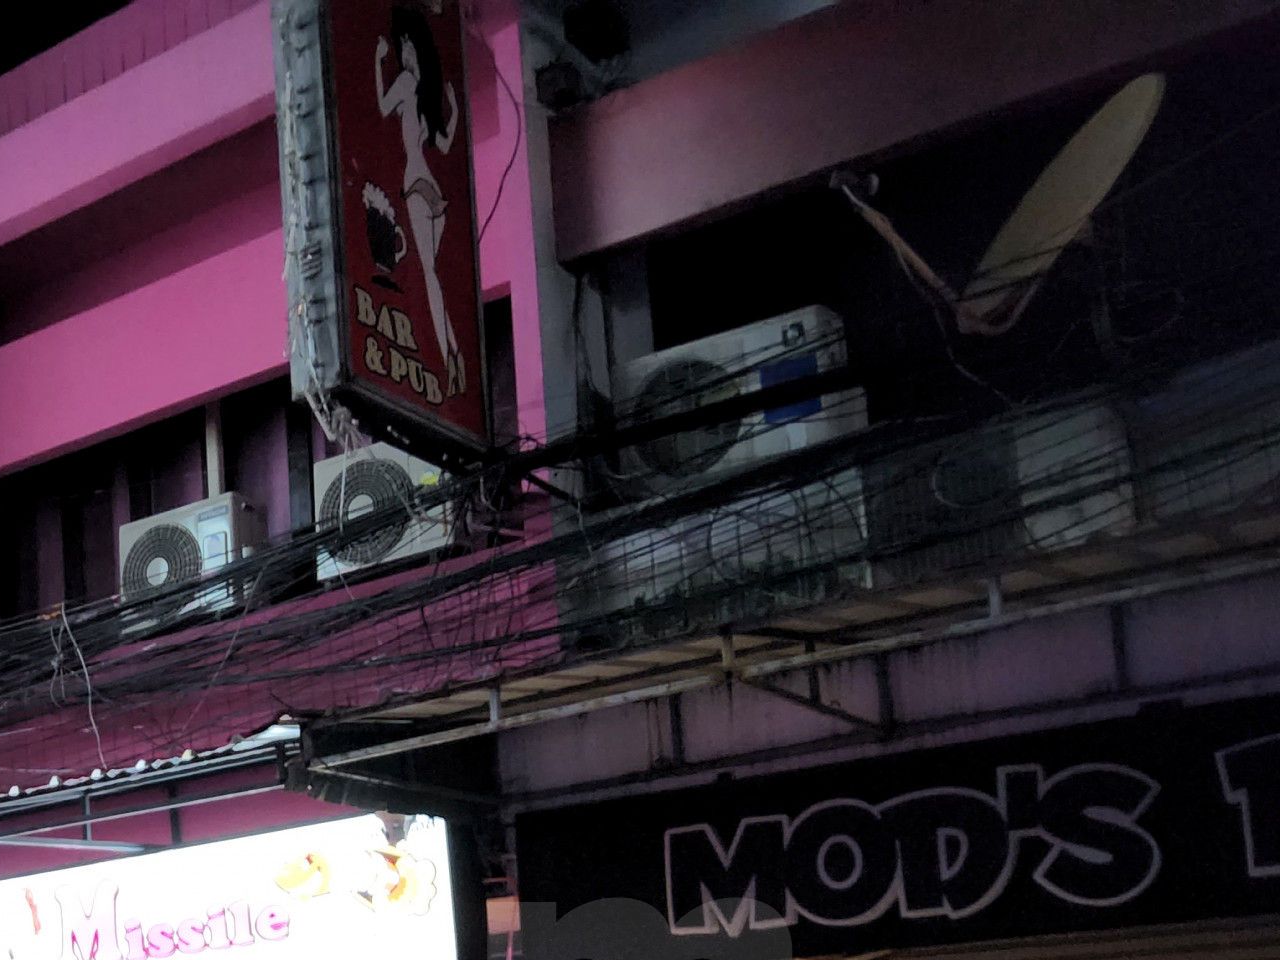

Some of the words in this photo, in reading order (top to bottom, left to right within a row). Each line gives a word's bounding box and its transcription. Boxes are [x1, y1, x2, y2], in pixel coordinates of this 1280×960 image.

[354, 286, 418, 350] BAR
[365, 334, 389, 378] &
[389, 349, 444, 405] PUB
[663, 762, 1162, 938] MOD'S
